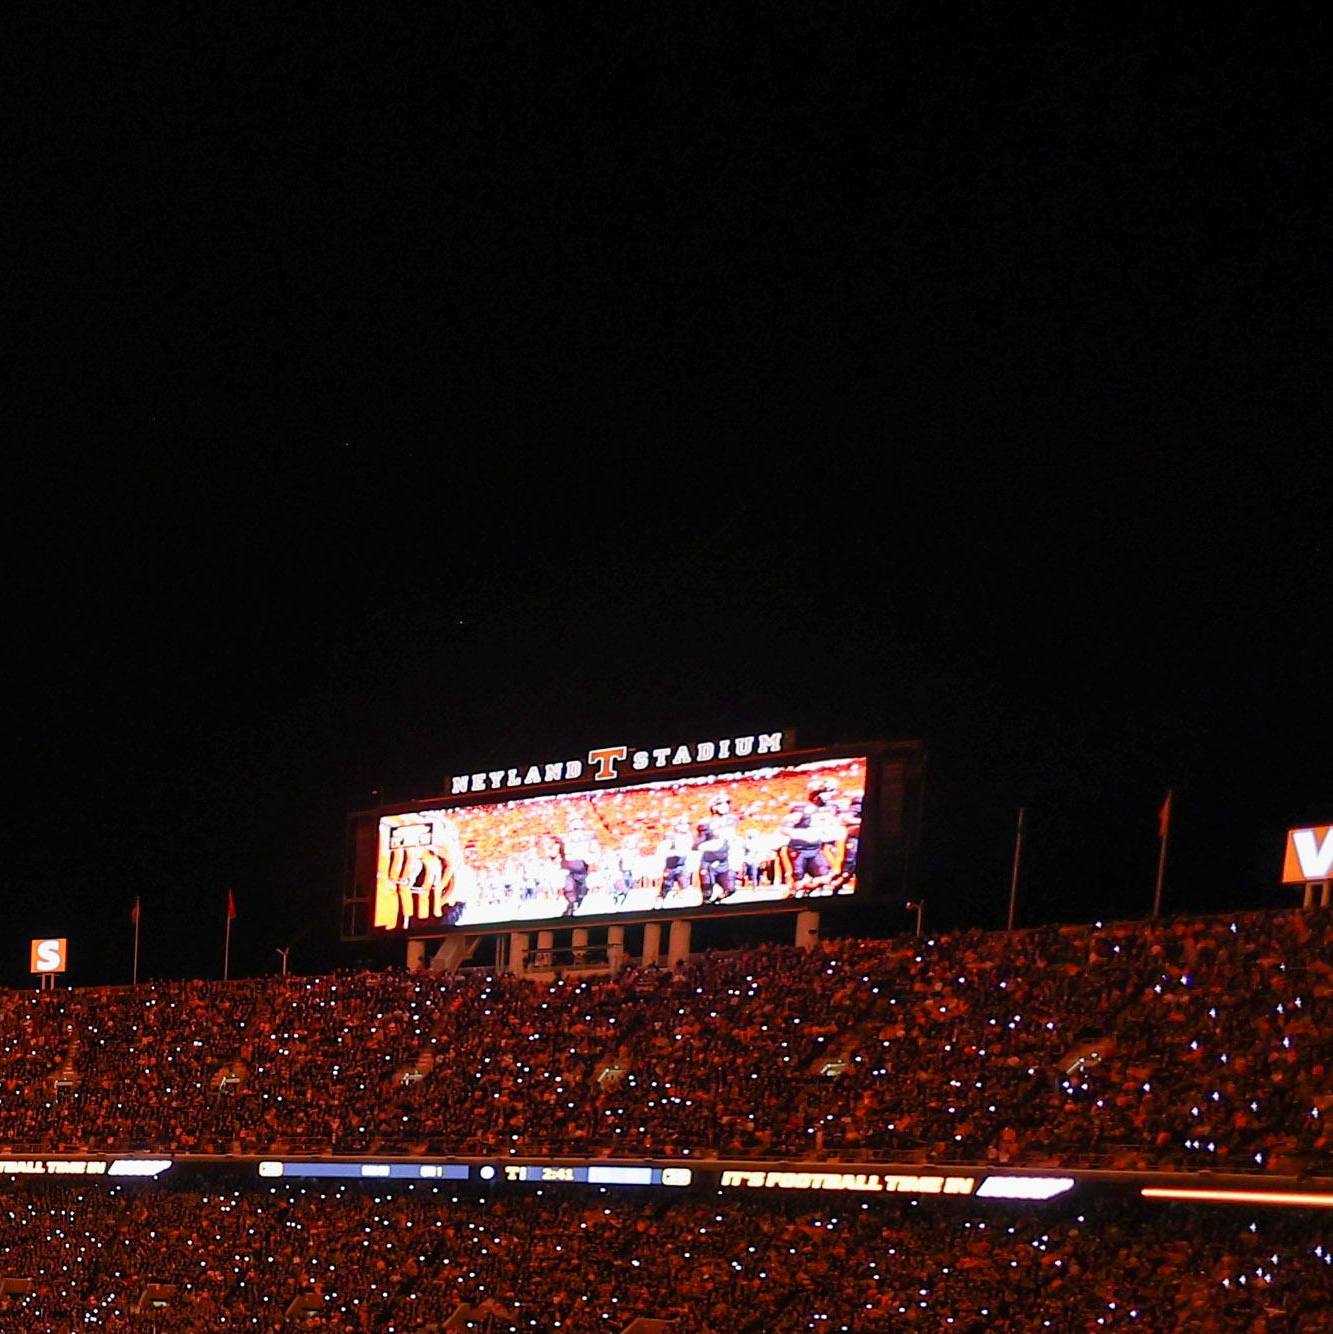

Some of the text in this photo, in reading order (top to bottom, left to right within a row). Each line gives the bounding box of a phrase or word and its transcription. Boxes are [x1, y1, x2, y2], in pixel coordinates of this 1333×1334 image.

[451, 732, 783, 794] NEYLAND T STADIUM
[1292, 828, 1333, 878] V
[720, 1171, 974, 1194] IT'S FOOTBALL TIME IN
